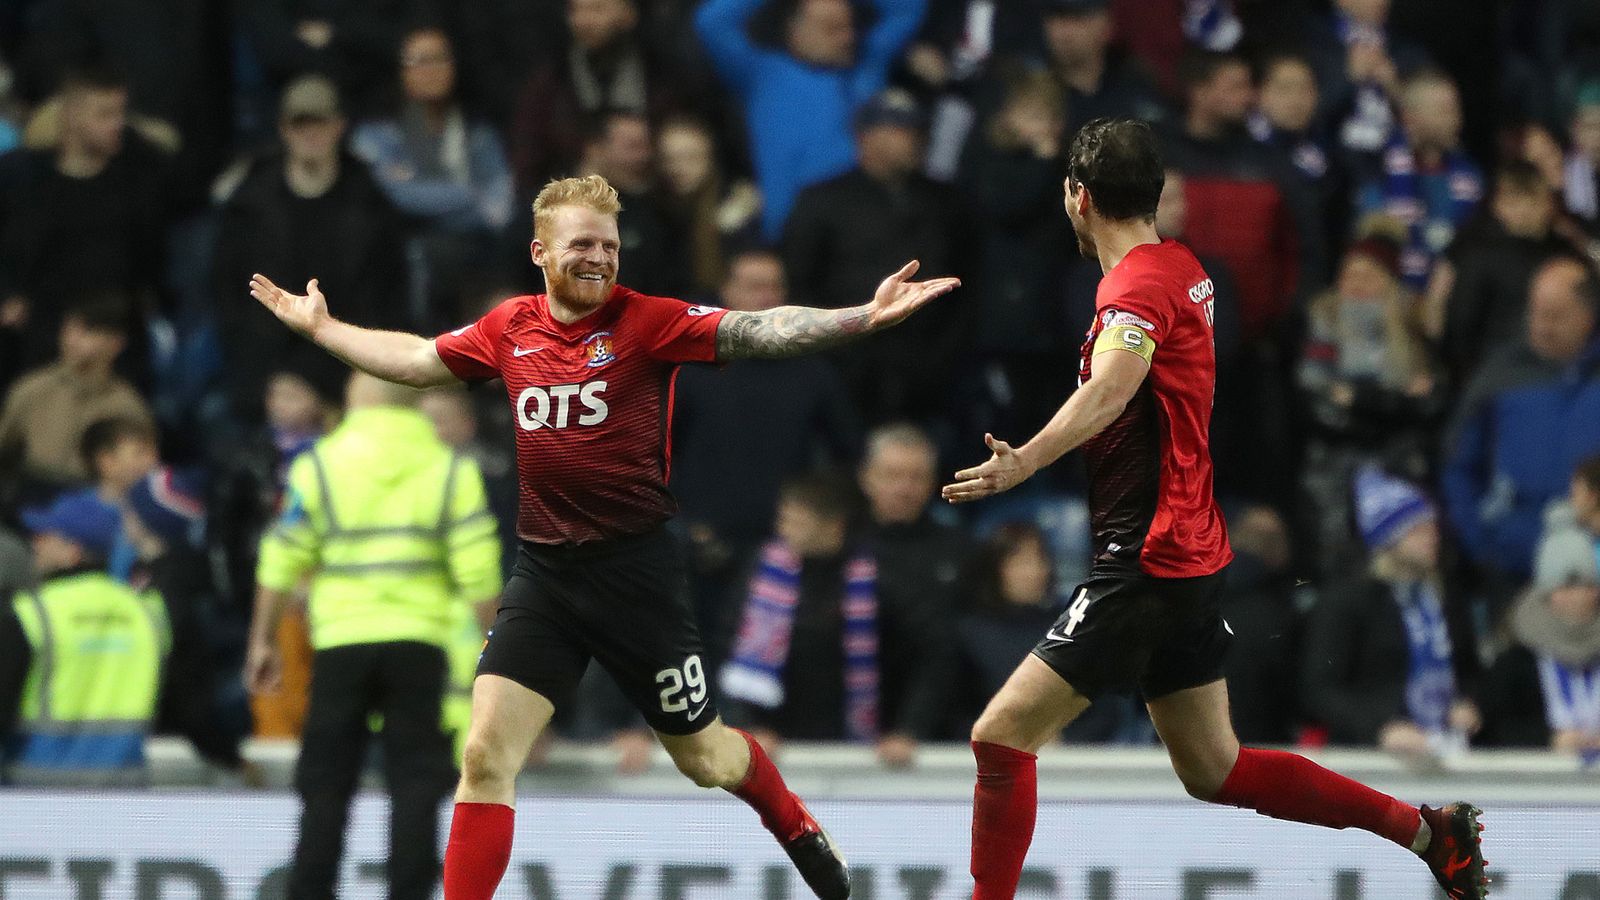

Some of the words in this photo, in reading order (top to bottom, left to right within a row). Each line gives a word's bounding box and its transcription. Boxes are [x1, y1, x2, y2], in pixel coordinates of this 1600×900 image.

[1123, 329, 1143, 348] C
[516, 380, 608, 431] QTS
[1063, 588, 1090, 636] 4
[655, 655, 707, 713] 29
